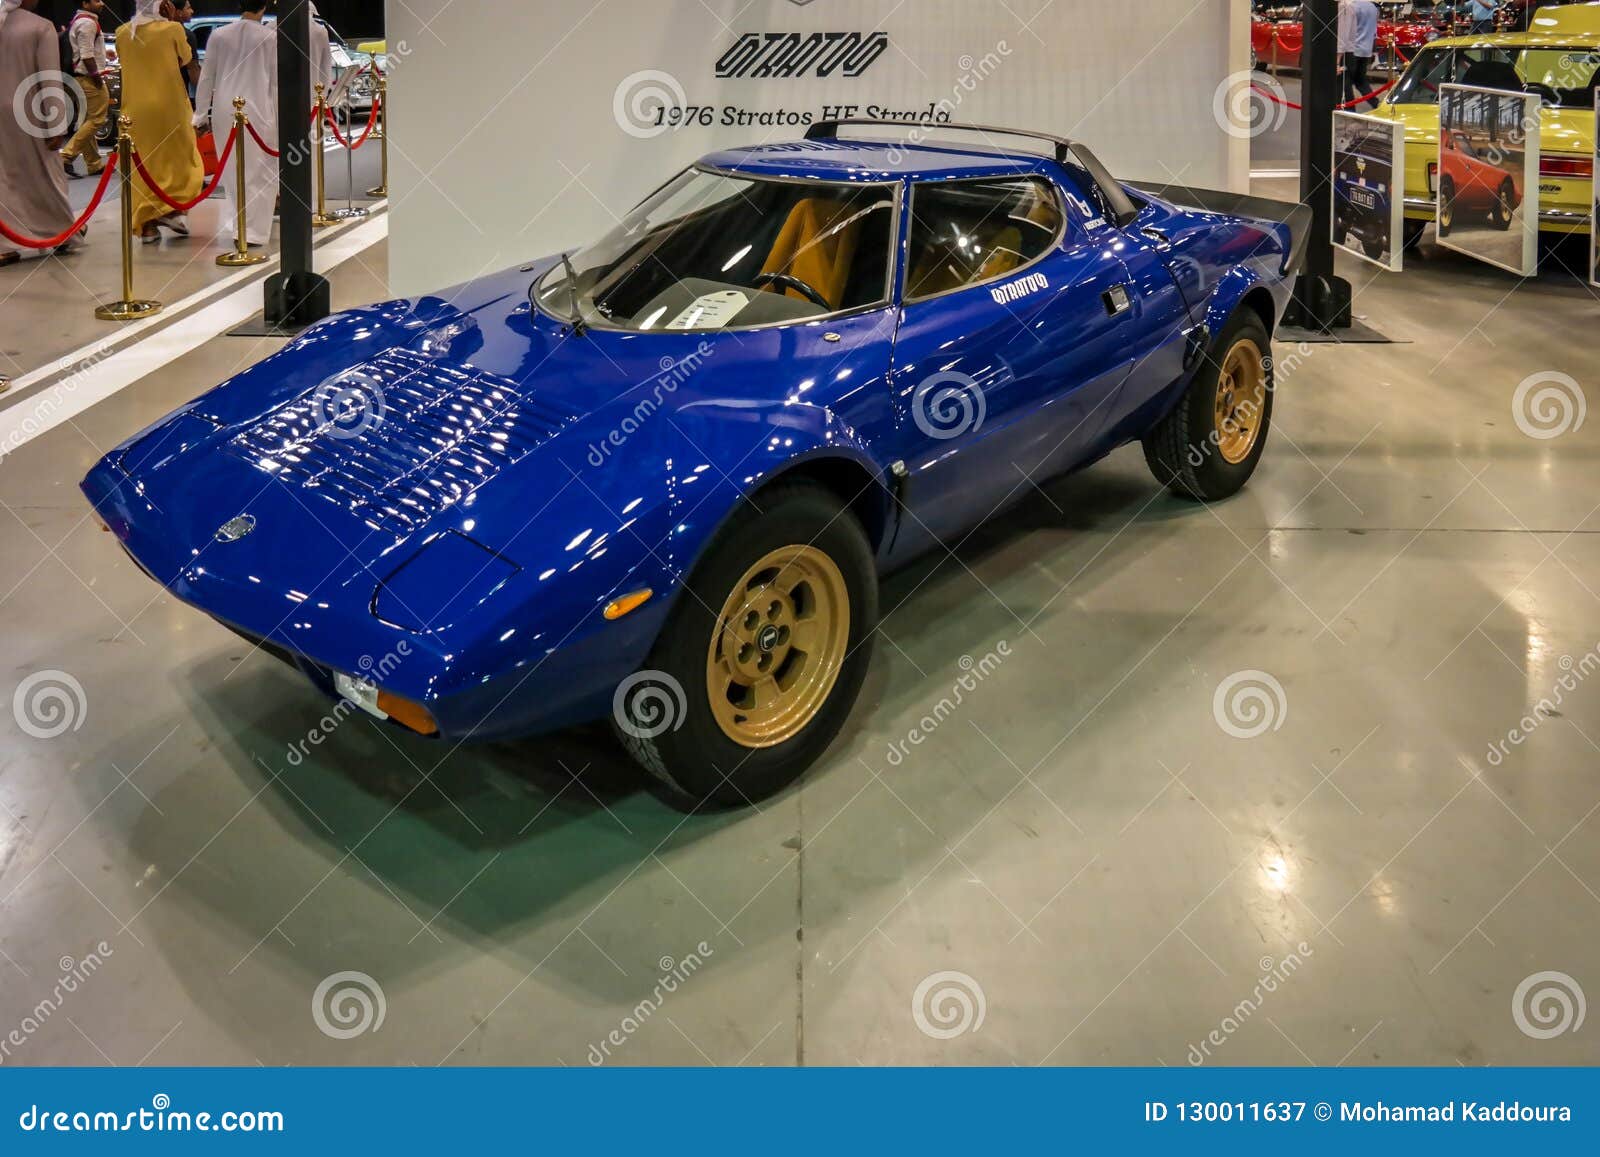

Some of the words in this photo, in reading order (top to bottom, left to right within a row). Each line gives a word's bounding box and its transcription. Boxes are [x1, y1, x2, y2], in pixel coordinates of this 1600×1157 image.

[715, 32, 888, 78] STRATOS
[654, 106, 714, 126] 1976
[720, 106, 813, 126] Stratos
[990, 272, 1049, 305] STRATOS
